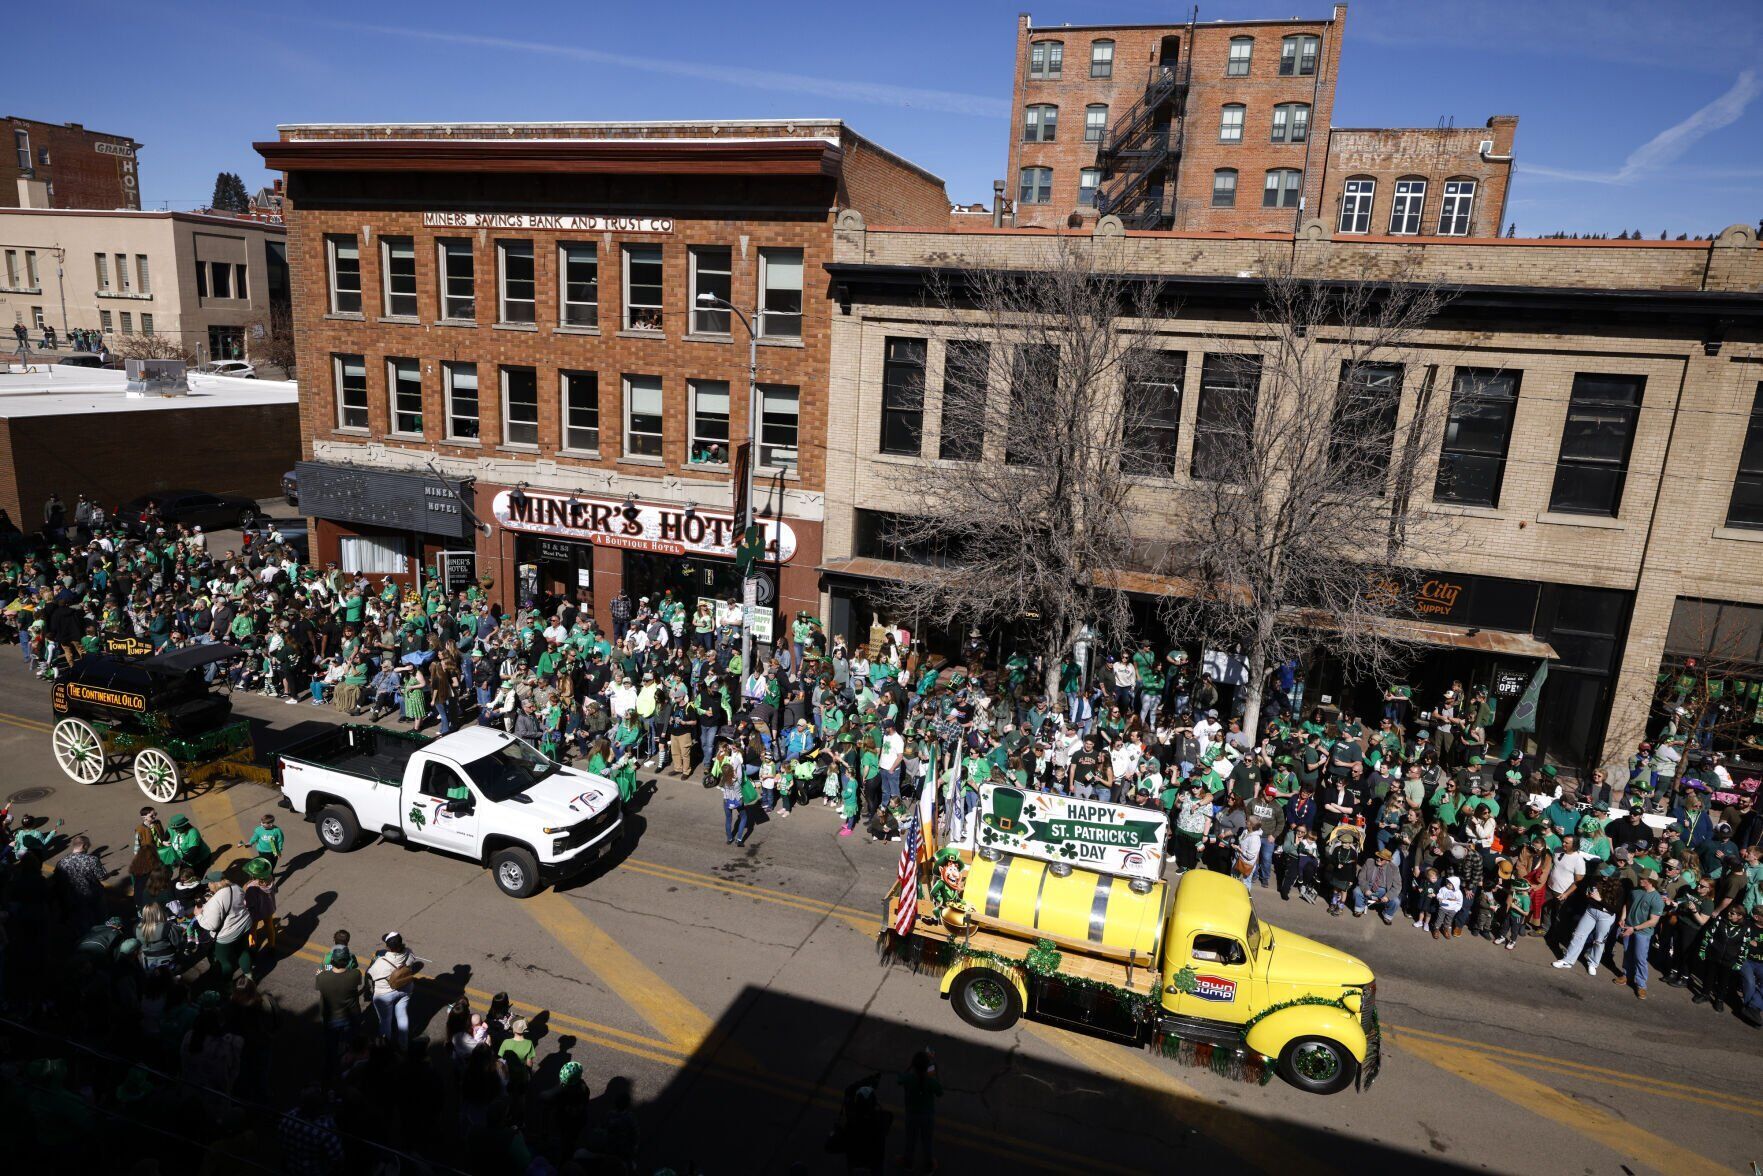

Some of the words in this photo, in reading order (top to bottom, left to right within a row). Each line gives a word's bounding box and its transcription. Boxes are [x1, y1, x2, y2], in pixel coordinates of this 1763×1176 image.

[97, 143, 132, 156] GRAND
[424, 212, 467, 226] MINERS
[475, 213, 523, 228] SAVINGS
[529, 215, 563, 229] BANK
[571, 217, 597, 230] AND
[602, 217, 644, 231] TRUST
[650, 218, 671, 232] CO
[428, 501, 457, 514] HOTEL
[507, 494, 643, 536] MINER'S
[596, 534, 602, 544] A
[605, 535, 648, 549] BOUTIQUE
[651, 541, 680, 553] HOTEL
[1418, 580, 1462, 606] City
[1416, 601, 1452, 615] SUPPLY
[107, 640, 127, 651] TOWN
[127, 638, 144, 655] PUMP
[69, 684, 81, 697] THE
[81, 687, 122, 704] CONTINENTAL
[122, 694, 133, 707] OIL
[133, 695, 144, 709] CO.
[1067, 804, 1117, 823] HAPPY
[1051, 824, 1070, 838] ST.
[1074, 825, 1139, 845] PATRICK'S
[1079, 843, 1107, 860] DAY
